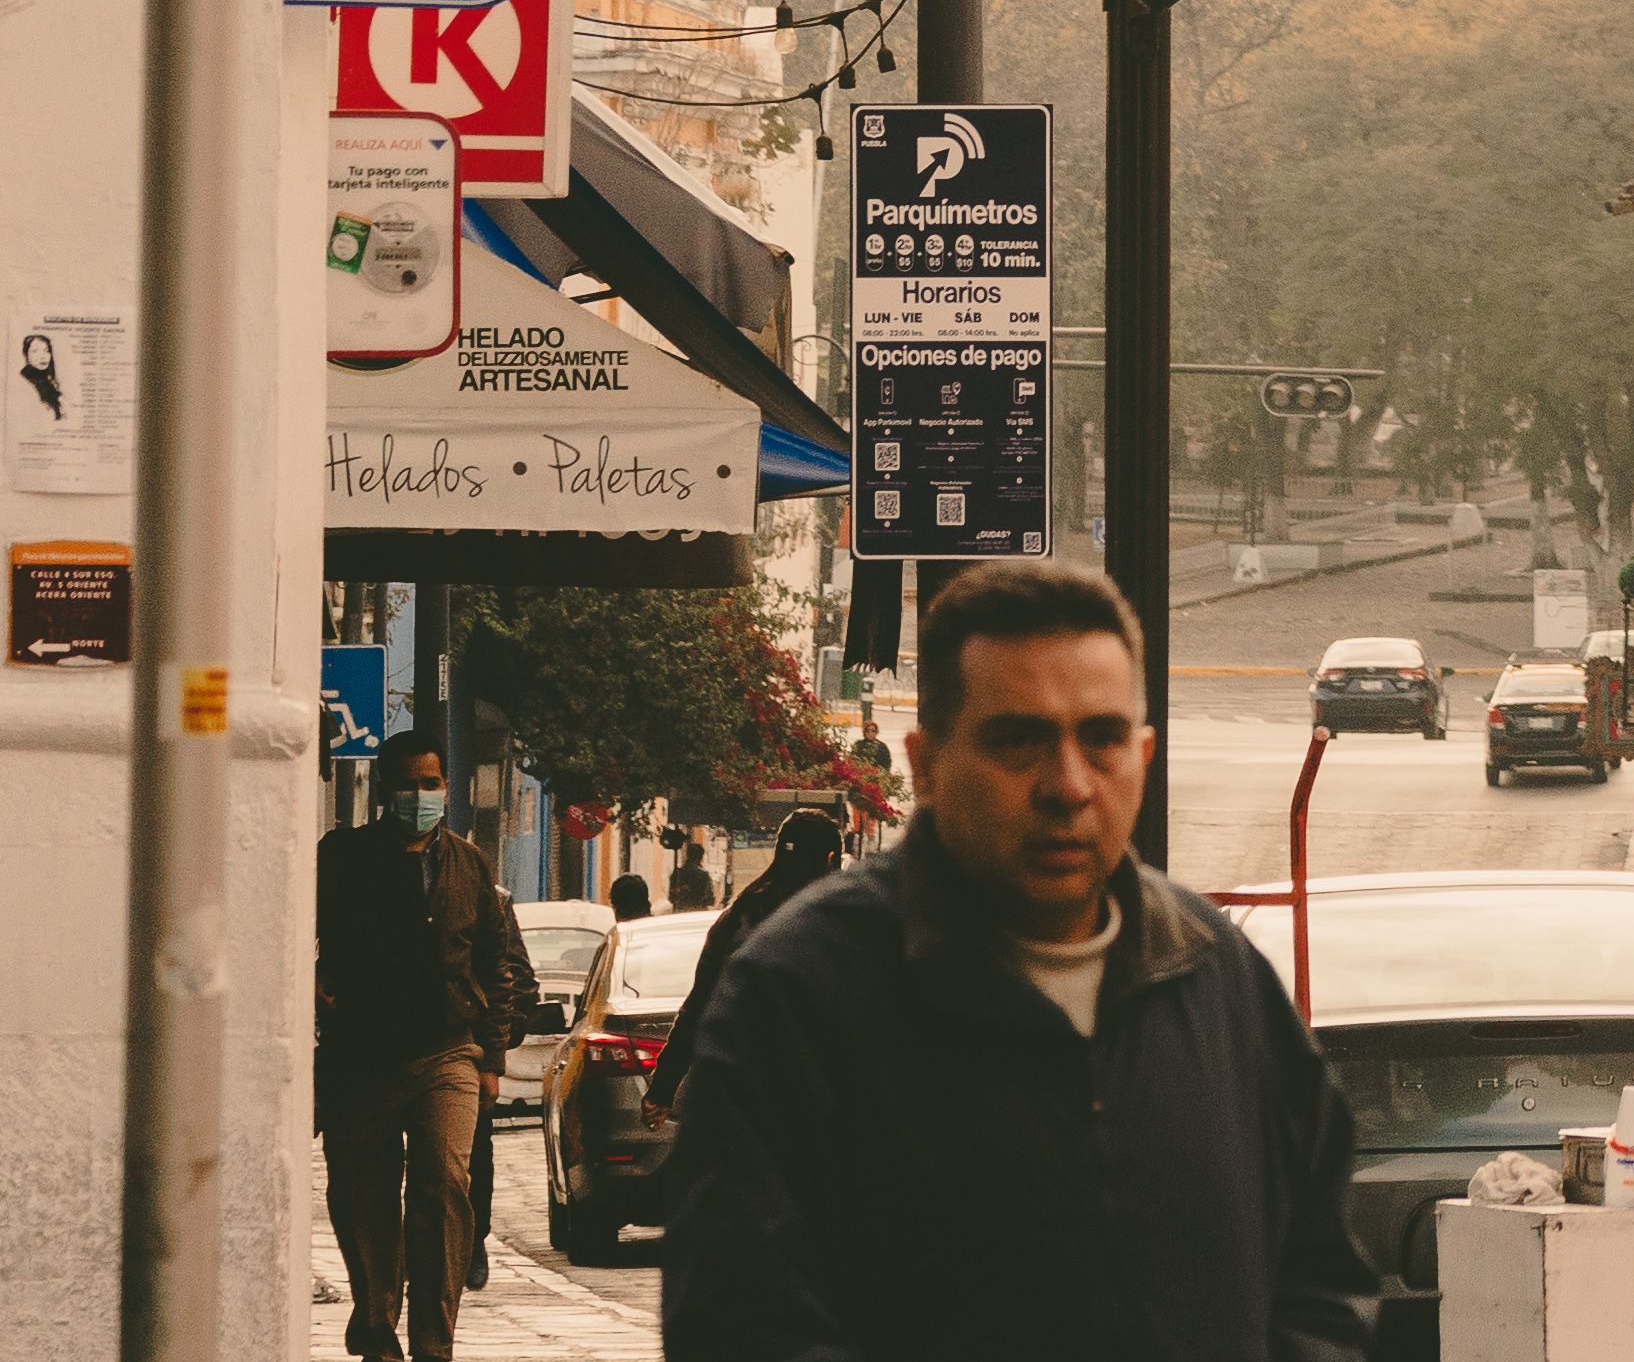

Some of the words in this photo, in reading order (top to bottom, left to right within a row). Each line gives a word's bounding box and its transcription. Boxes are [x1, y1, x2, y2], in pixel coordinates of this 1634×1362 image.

[335, 139, 386, 151] REALIZA
[389, 137, 423, 151] AQUÍ
[348, 166, 363, 176] Tu
[367, 167, 401, 179] pago
[405, 167, 428, 176] con
[328, 179, 372, 192] tarjeta
[376, 178, 449, 191] inteligente
[866, 198, 1038, 231] Parquímetros
[980, 241, 1039, 250] TOLERANCIA
[956, 258, 973, 268] $10
[980, 252, 1001, 268] 10
[1005, 252, 1041, 268] min.
[902, 280, 1002, 304] Horarios
[864, 312, 891, 324] LUN
[901, 312, 923, 324] VIE
[955, 308, 982, 323] SÁB
[1009, 312, 1040, 323] DOM
[458, 327, 565, 348] HELADO
[458, 350, 629, 367] DELIZZIOSAMENTE
[861, 344, 957, 371] Opciones
[960, 344, 987, 366] de
[990, 349, 1042, 371] pago
[458, 369, 629, 392] ARTESANAL
[325, 433, 490, 503] Helados
[543, 433, 699, 505] Paletas
[30, 570, 61, 579] CALLE
[66, 581, 108, 589] ORIENTE
[35, 591, 67, 599] ACERA
[69, 590, 112, 599] ORIENTE
[71, 639, 105, 648] NORTE
